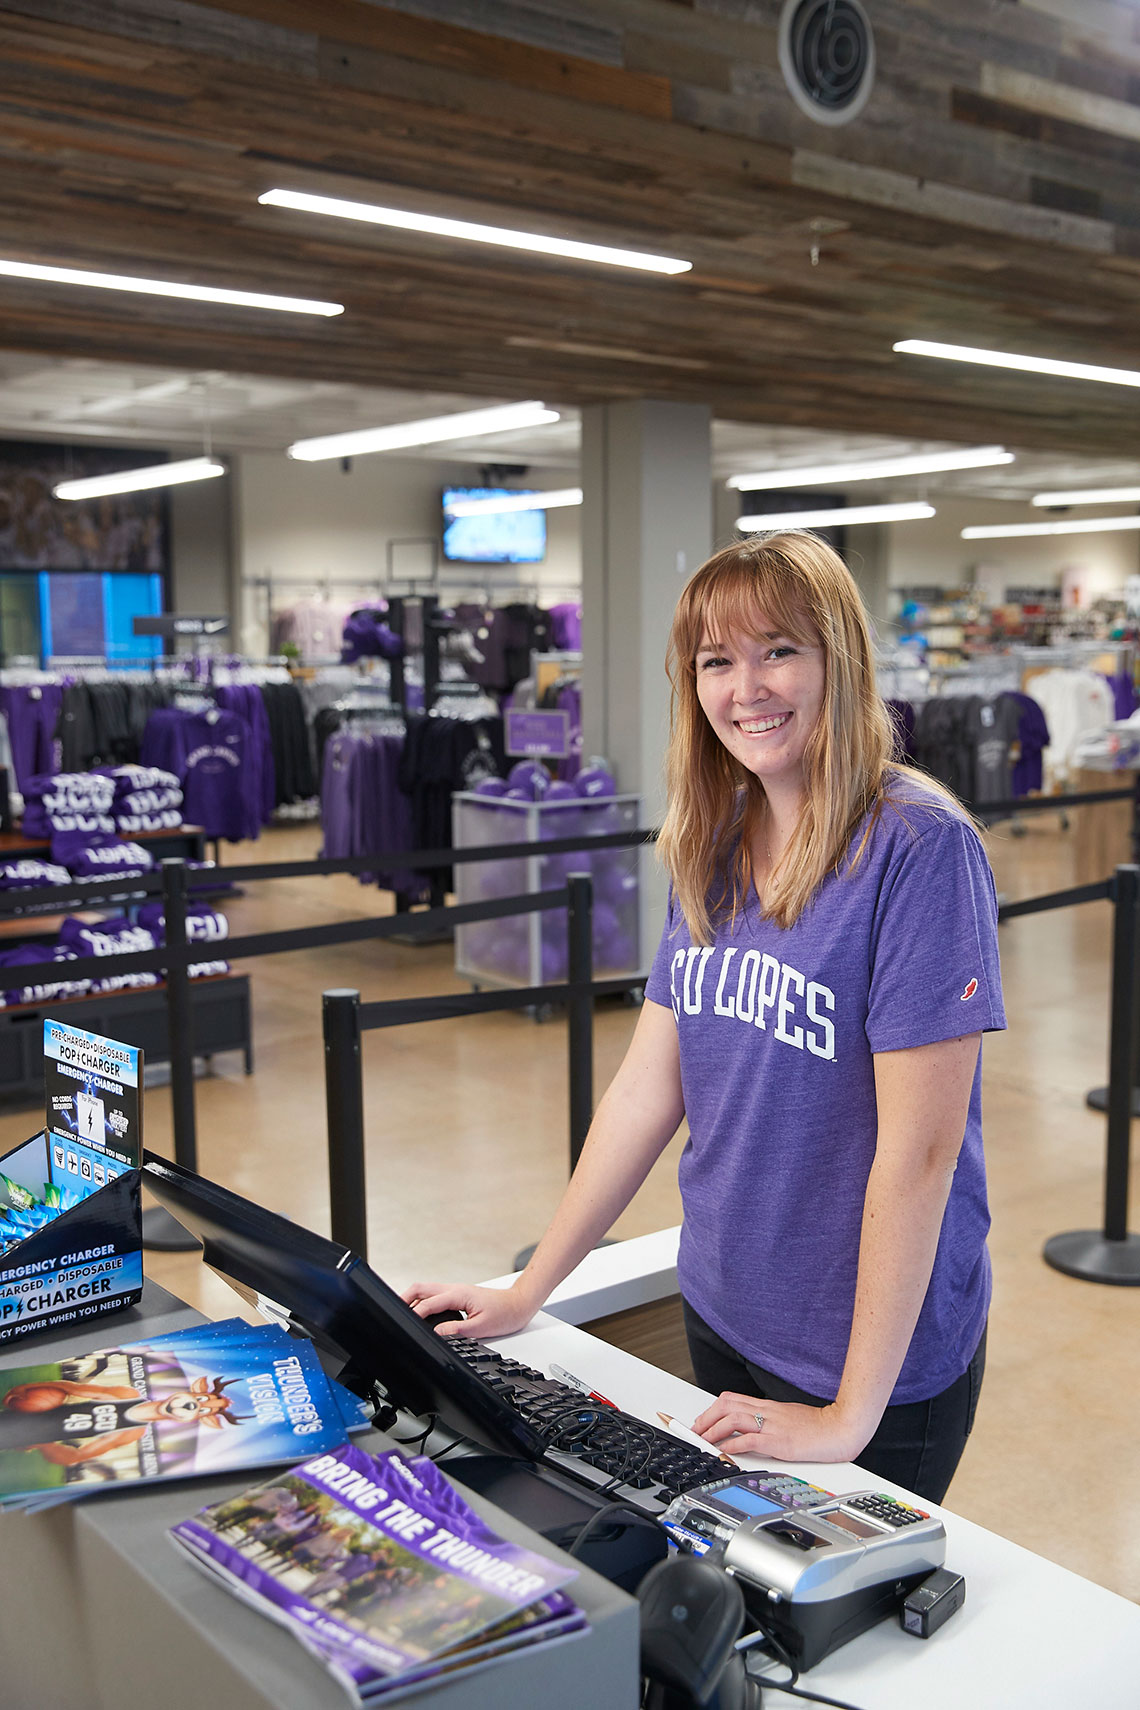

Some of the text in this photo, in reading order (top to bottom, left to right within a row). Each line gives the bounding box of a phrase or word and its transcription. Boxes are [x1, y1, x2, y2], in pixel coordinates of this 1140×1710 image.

[713, 947, 835, 1060] LOPES
[51, 1028, 130, 1064] PRE-CHARGED DISPOSABLE
[60, 1045, 120, 1077] POP CHARGER
[57, 1062, 124, 1096] EMERGENCY CHARGER
[0, 1244, 115, 1281] ERGENCY CHARGER
[57, 1258, 123, 1283] DISPOSABLE
[26, 1278, 112, 1312] CHARGER
[15, 1319, 47, 1335] POWER
[49, 1311, 77, 1324] WHEN
[78, 1305, 98, 1317] YOU
[99, 1299, 122, 1311] NEED
[123, 1296, 132, 1305] IT
[130, 1356, 146, 1380] GRAND
[246, 1373, 286, 1424] VISION
[272, 1356, 324, 1436] THUNDER'S
[63, 1413, 93, 1432] 49
[92, 1404, 119, 1432] GCU
[302, 1454, 389, 1510] BRING
[374, 1498, 436, 1541] THE
[419, 1527, 547, 1597] THUNDER
